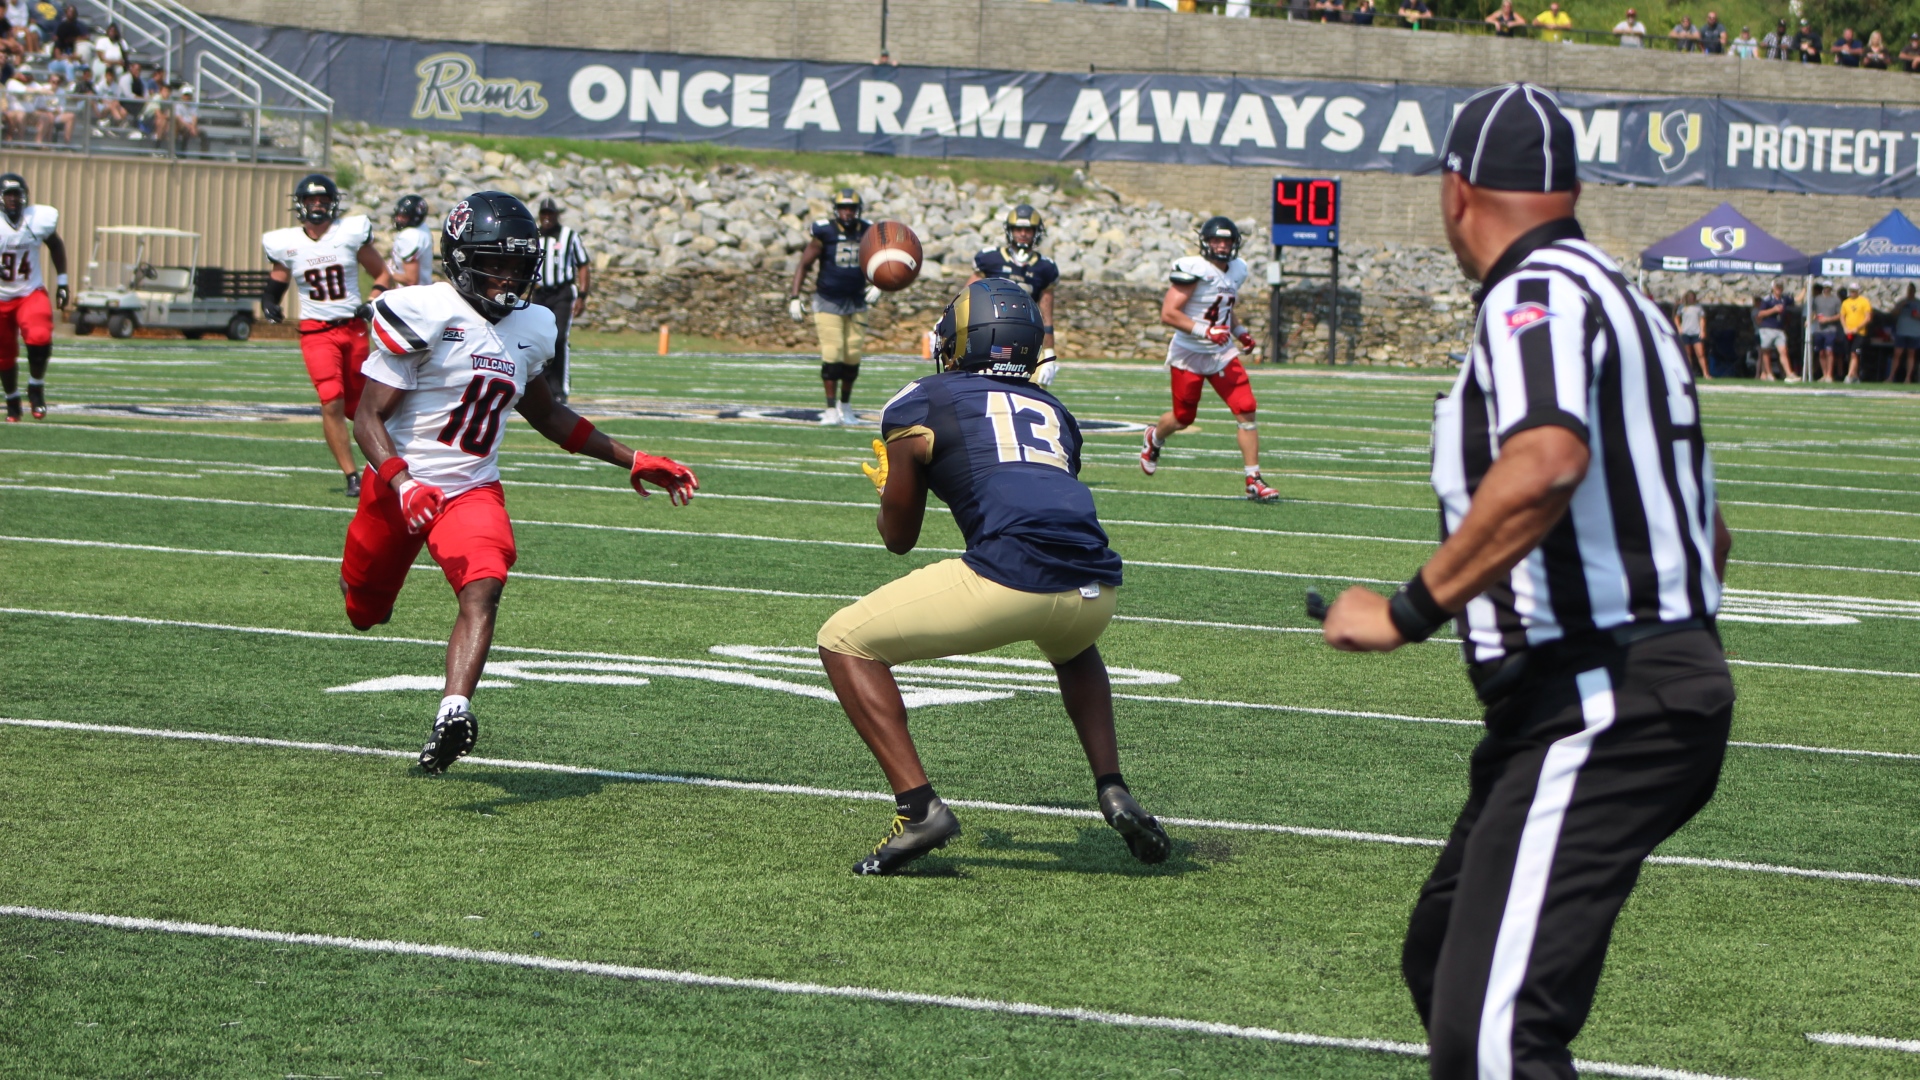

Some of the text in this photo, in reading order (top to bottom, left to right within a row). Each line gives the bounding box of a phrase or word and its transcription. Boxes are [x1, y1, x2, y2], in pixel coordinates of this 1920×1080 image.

[412, 52, 548, 121] Rams
[568, 64, 770, 129] ONCE
[783, 77, 841, 132] A
[858, 80, 1048, 148] RAM,
[1061, 88, 1367, 153] ALWAYS
[1378, 100, 1435, 155] A
[1727, 122, 1904, 177] PROTECT
[1277, 180, 1334, 226] 40
[1, 250, 31, 282] 94
[304, 264, 346, 301] 30
[1855, 262, 1890, 273] PROTECT
[1891, 263, 1904, 273] THIS
[443, 331, 465, 339] PSAC
[471, 354, 516, 377] VULCANS
[993, 361, 1026, 373] schutt
[437, 375, 516, 458] 10
[985, 391, 1069, 473] 13
